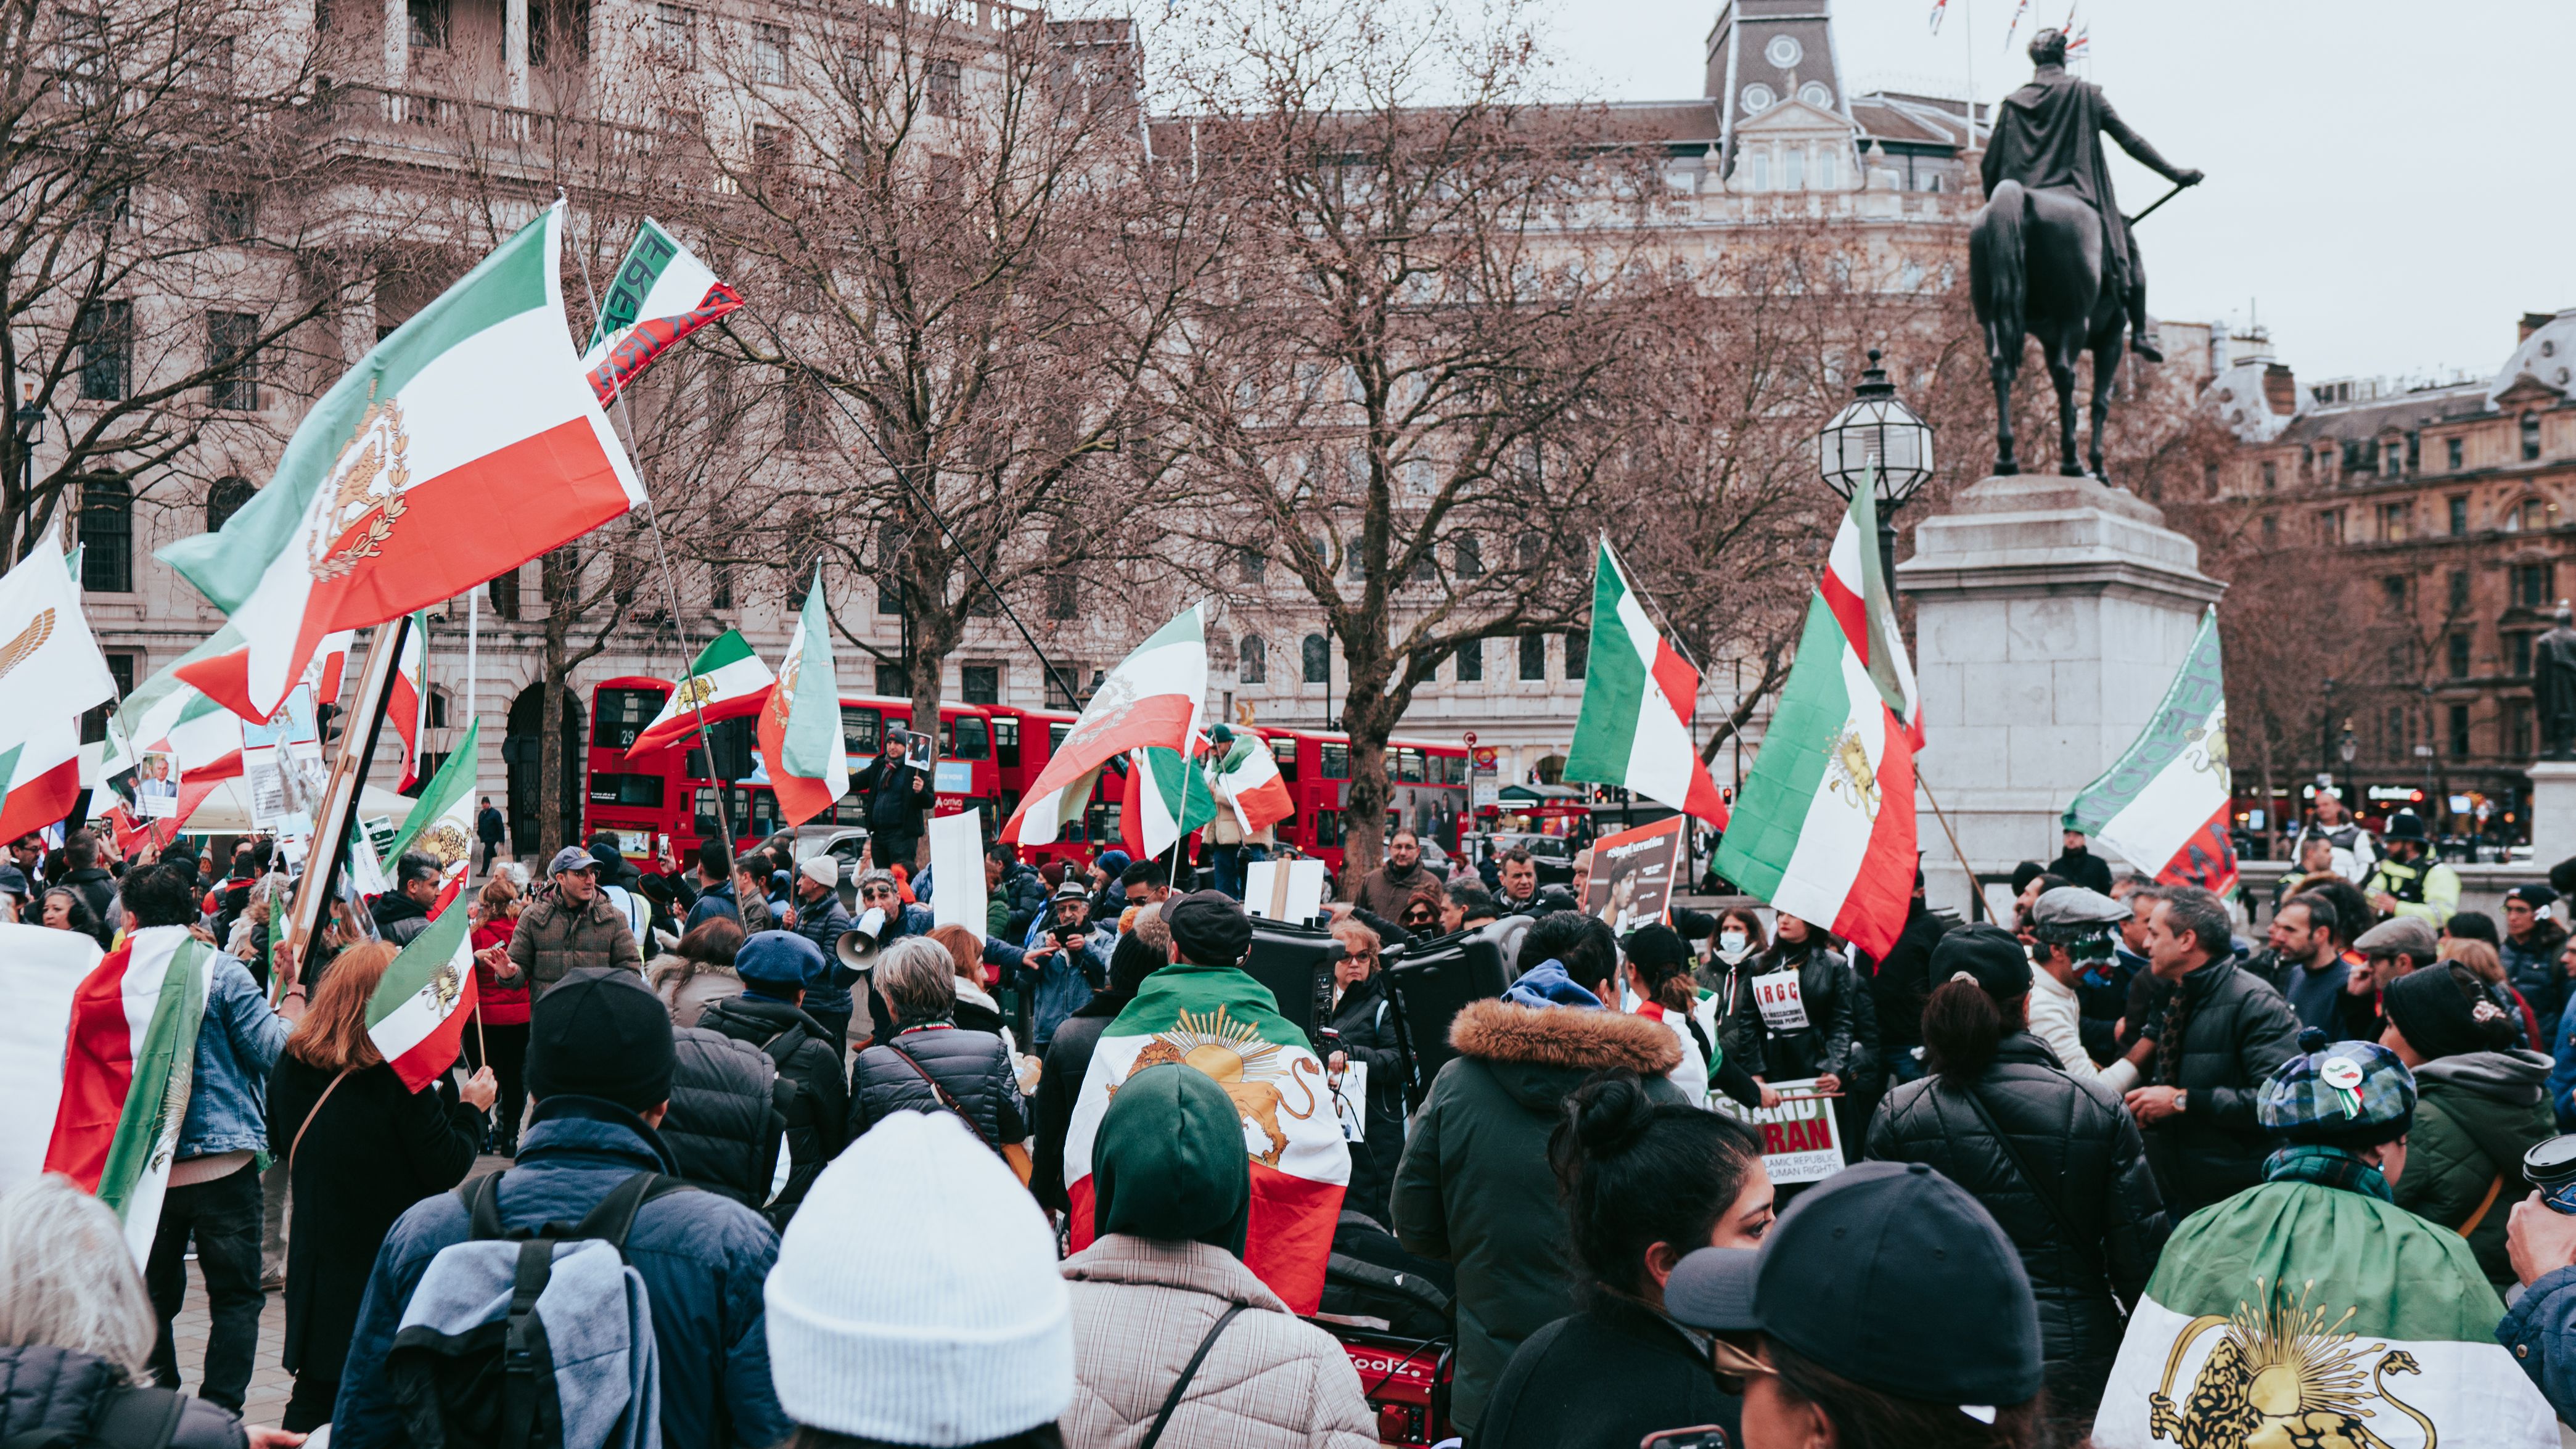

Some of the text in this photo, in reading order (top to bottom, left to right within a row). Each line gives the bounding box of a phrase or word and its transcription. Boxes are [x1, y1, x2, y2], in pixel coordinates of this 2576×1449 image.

[621, 729, 635, 745] 29
[1465, 734, 1474, 745] C
[943, 797, 962, 807] arriva
[367, 822, 392, 835] etition
[1756, 981, 1799, 1007] IRGC
[1765, 1152, 1837, 1168] LAMIC REPUBLIC
[1803, 1163, 1840, 1176] RIGHTS
[1347, 1353, 1409, 1375] oolz
